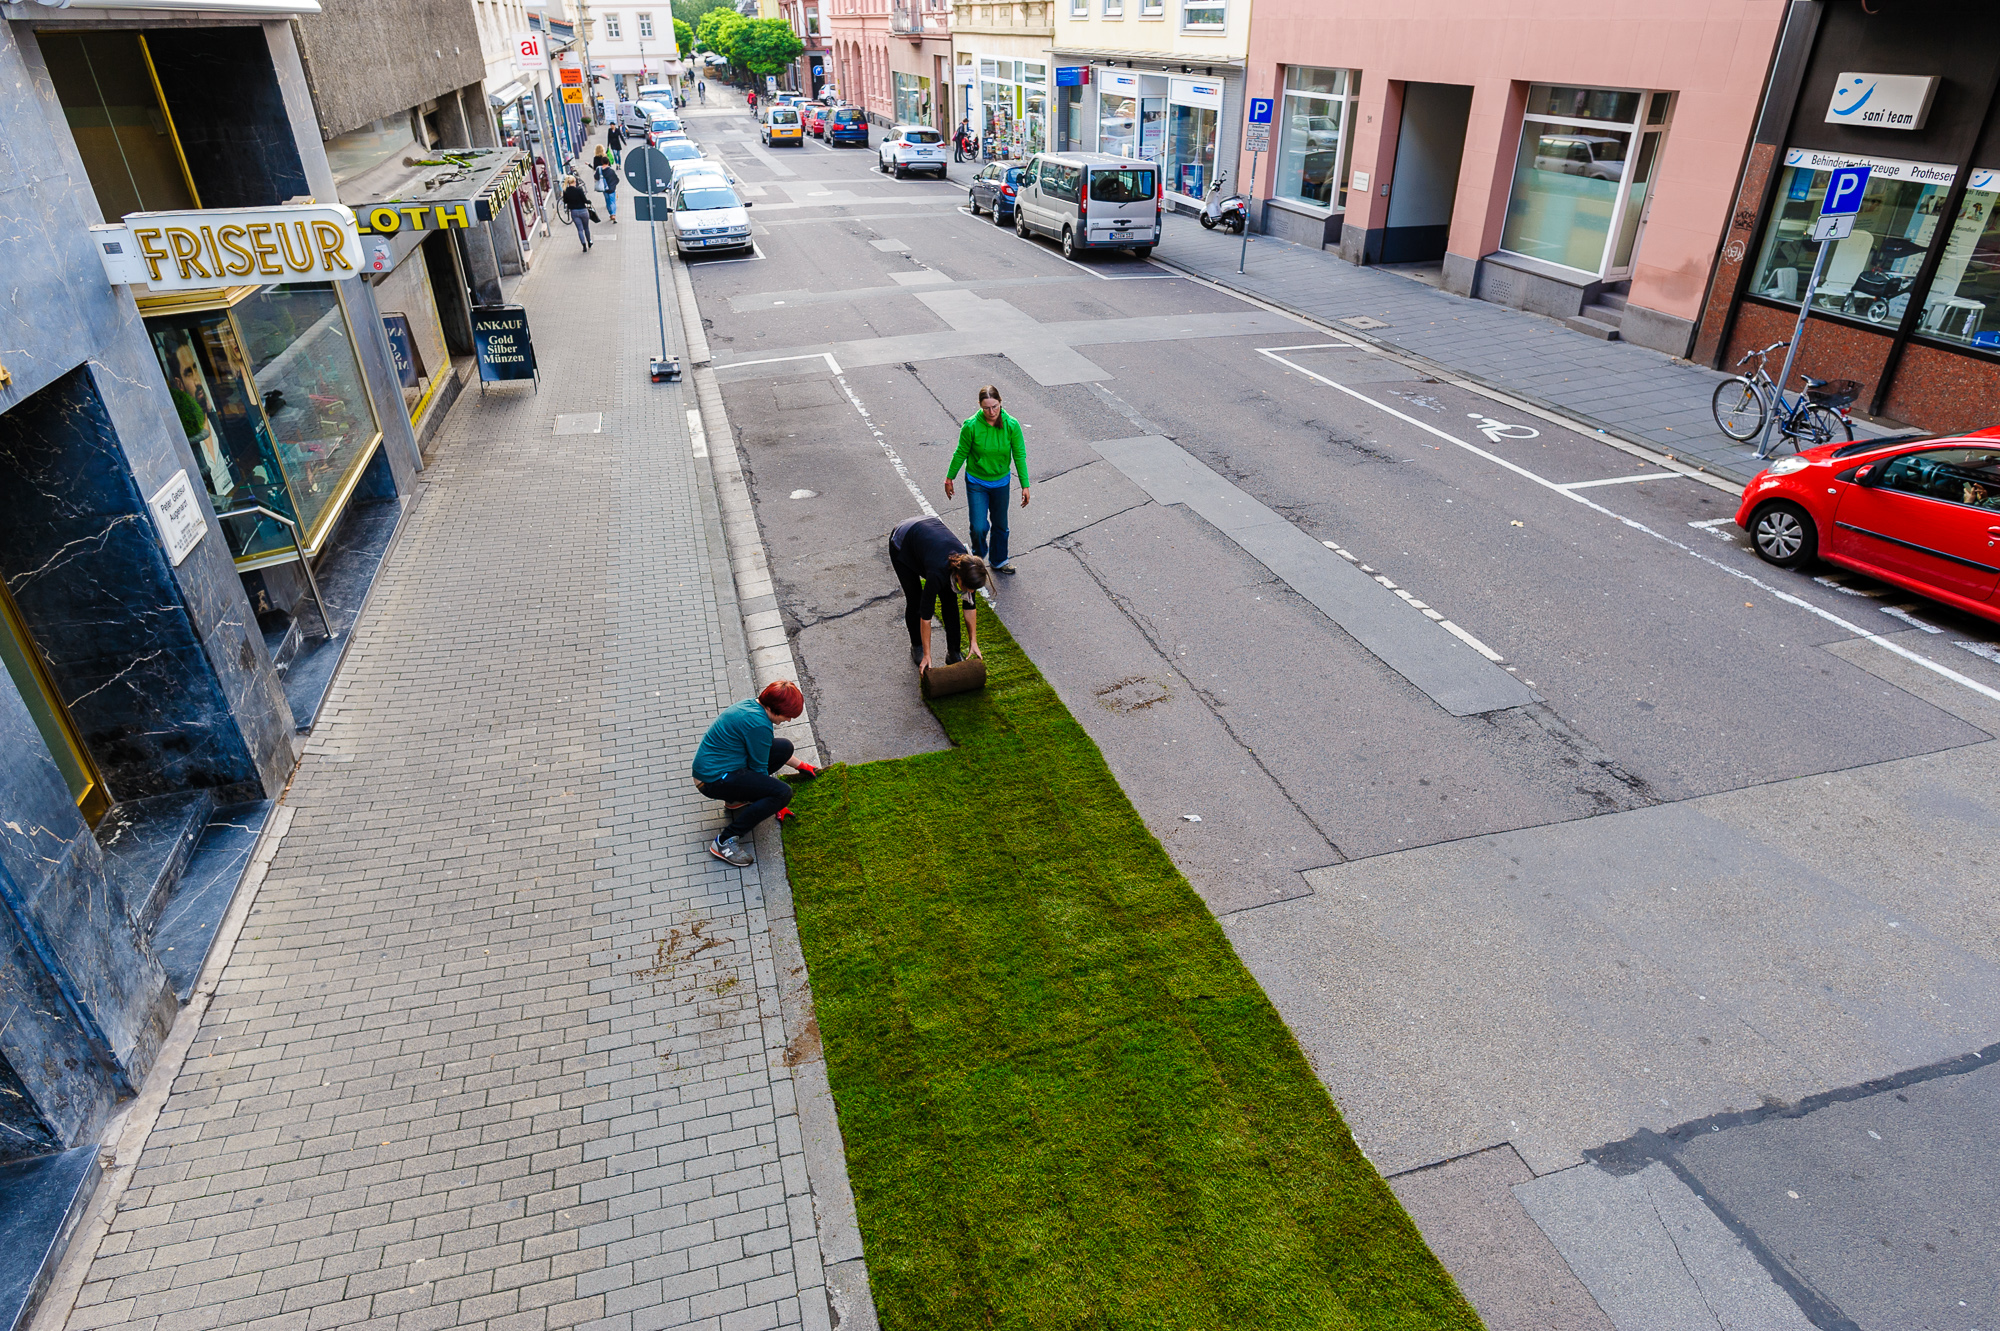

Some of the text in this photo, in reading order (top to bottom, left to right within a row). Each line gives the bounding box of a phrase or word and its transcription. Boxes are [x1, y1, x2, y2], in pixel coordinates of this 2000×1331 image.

[520, 36, 538, 56] ai
[1254, 101, 1268, 120] P
[1862, 108, 1913, 124] sani team
[1831, 173, 1859, 209] P
[353, 204, 469, 234] LOTH
[134, 220, 353, 281] FRISEUR
[475, 319, 523, 331] ANKAUF
[488, 334, 514, 345] Gold
[487, 344, 518, 354] Silber
[483, 354, 525, 364] Münzen
[160, 497, 173, 514] Peter
